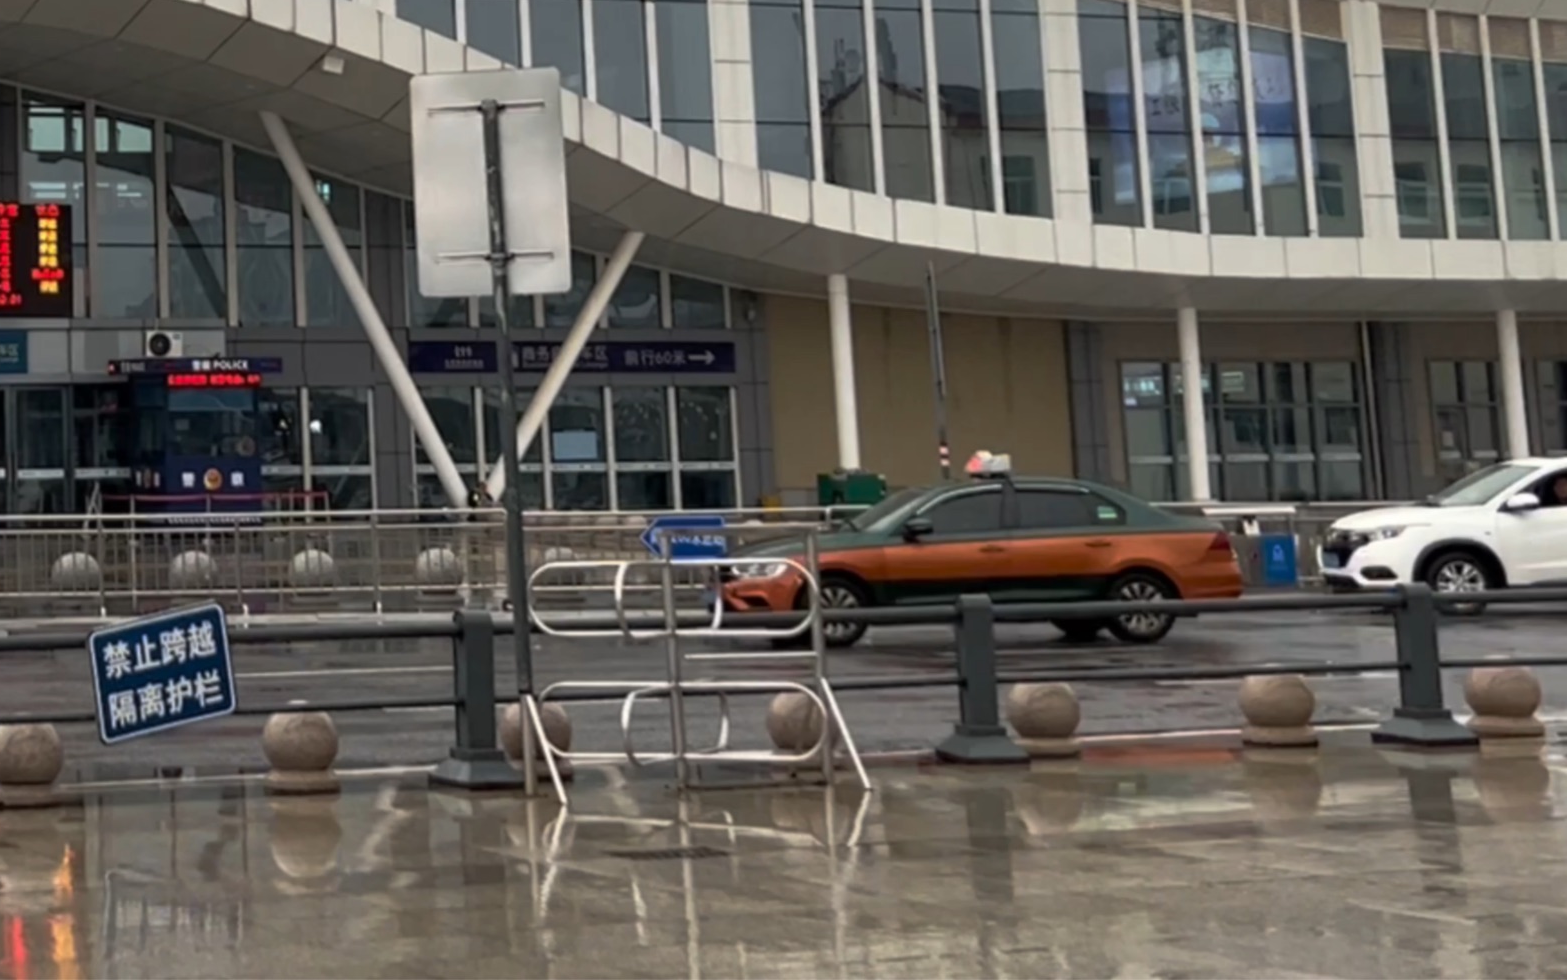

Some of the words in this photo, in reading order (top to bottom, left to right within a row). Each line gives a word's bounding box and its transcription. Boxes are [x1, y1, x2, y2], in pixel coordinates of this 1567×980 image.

[214, 358, 251, 371] POLICE
[102, 619, 217, 680] 禁止跨越
[107, 668, 224, 730] 隔离护栏
